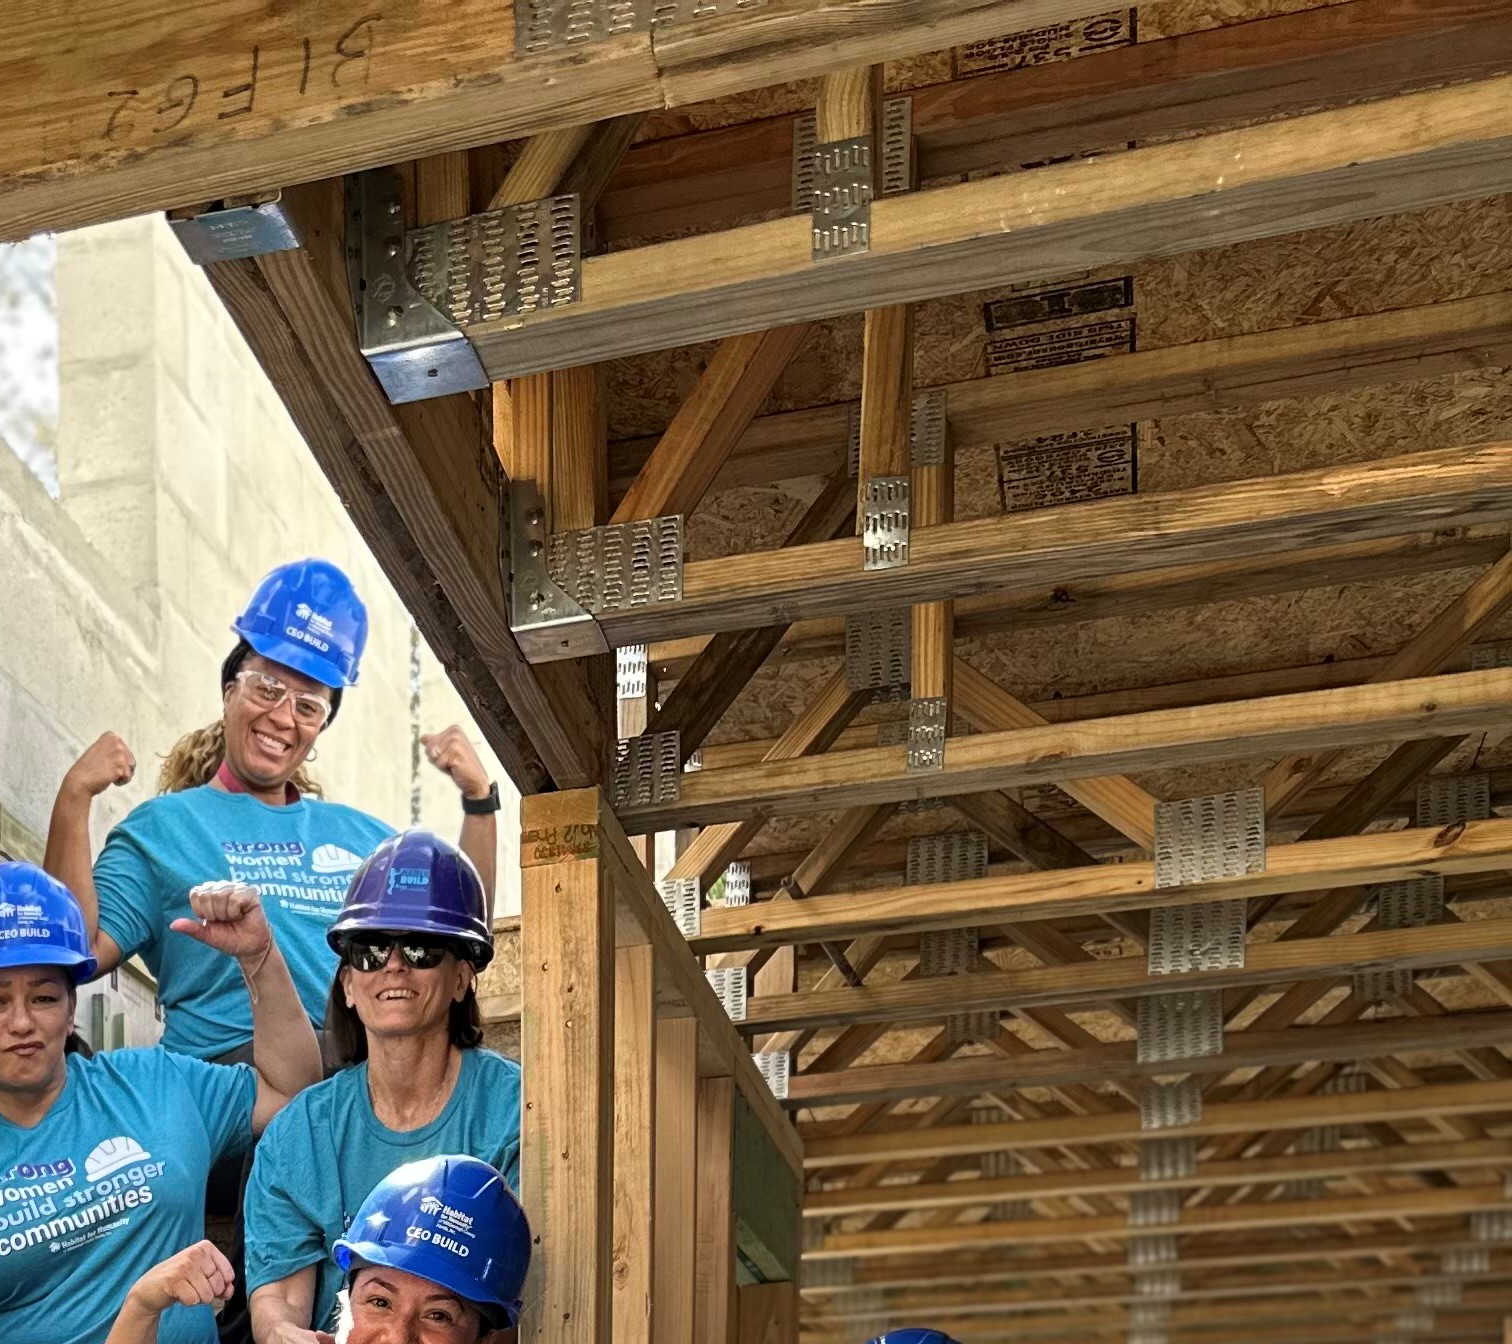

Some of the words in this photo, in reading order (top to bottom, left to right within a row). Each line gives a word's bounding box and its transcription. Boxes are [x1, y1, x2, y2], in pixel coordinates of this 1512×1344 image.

[303, 633, 330, 652] BUILD
[222, 840, 305, 857] strong
[225, 854, 302, 867] women
[230, 866, 287, 884] build
[292, 872, 356, 886] strong
[256, 880, 347, 903] ommunitie
[20, 928, 51, 938] BUILD
[0, 1157, 77, 1183] rong
[63, 1159, 167, 1207] stronger
[406, 1226, 431, 1241] CEO
[432, 1233, 470, 1258] BUILD
